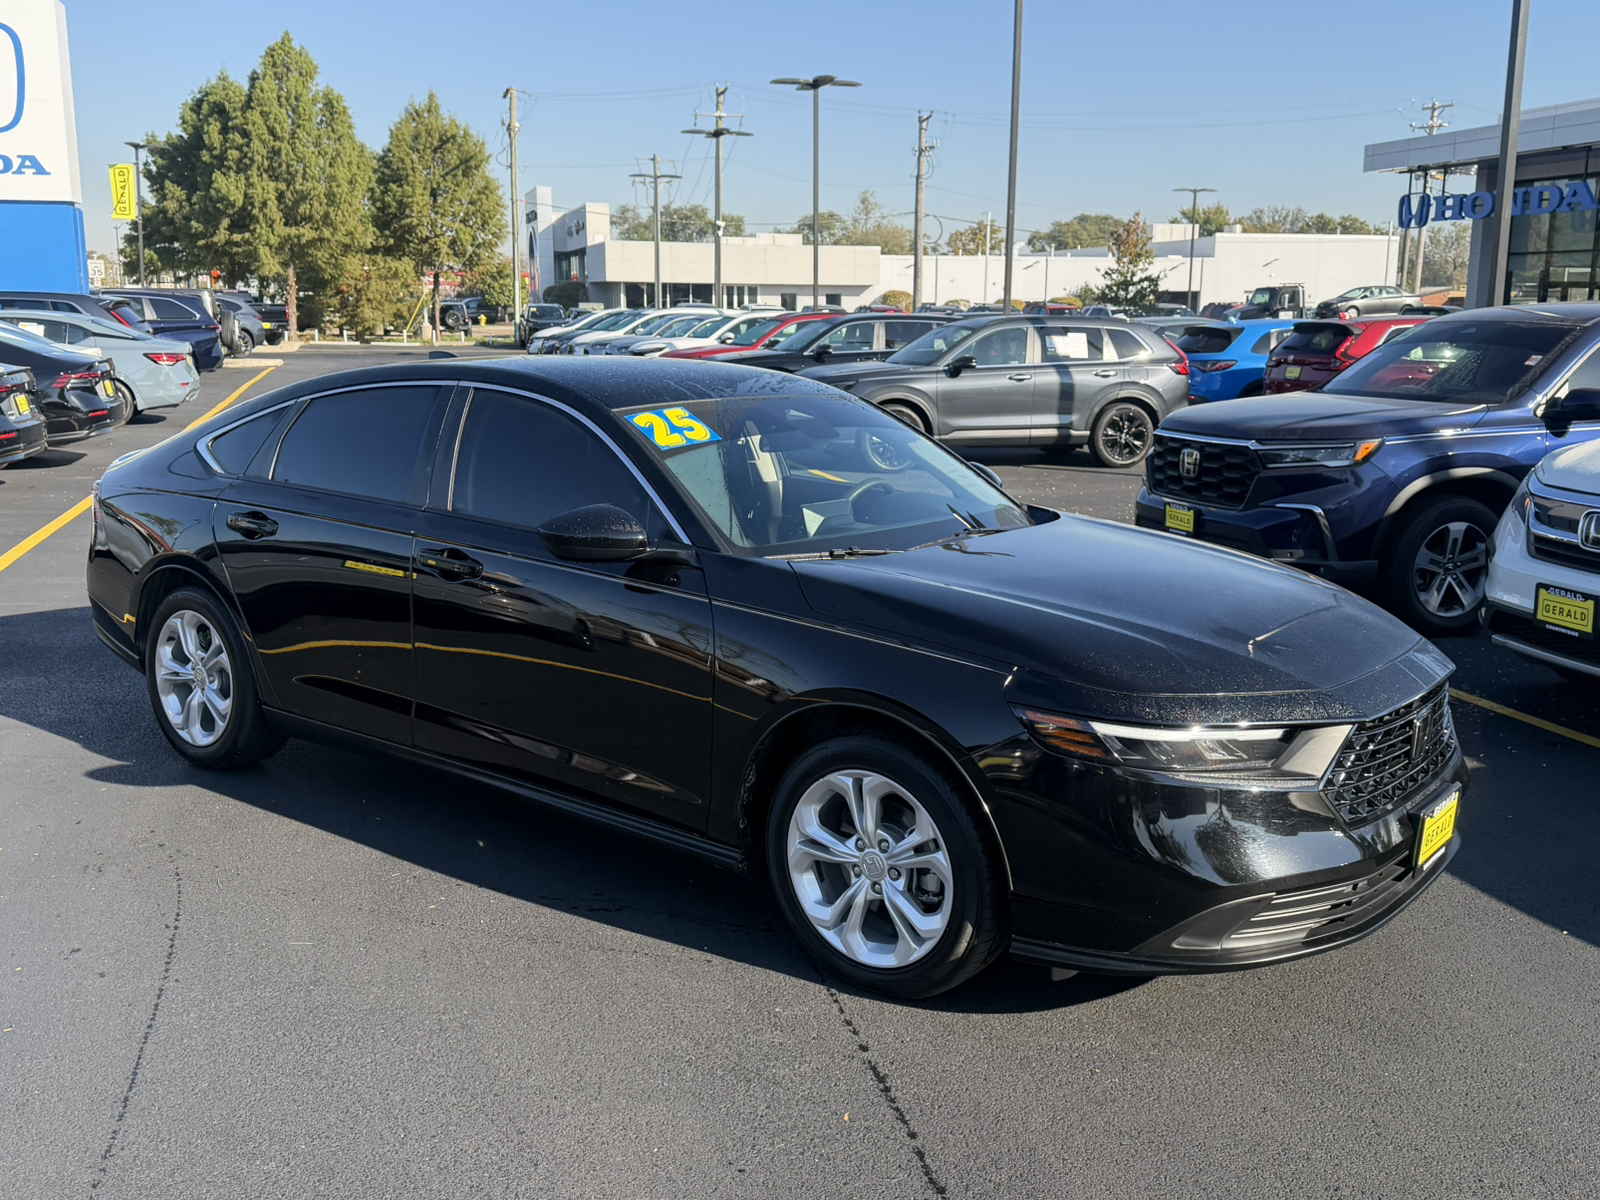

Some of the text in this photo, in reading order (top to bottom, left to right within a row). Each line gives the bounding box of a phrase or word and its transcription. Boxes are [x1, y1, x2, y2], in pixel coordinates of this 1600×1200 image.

[117, 170, 127, 213] GERALD
[1431, 181, 1599, 221] HONDA
[633, 408, 711, 447] 25
[1169, 513, 1190, 525] GERALD
[1544, 604, 1587, 622] GERALD
[1425, 814, 1453, 847] GERALD
